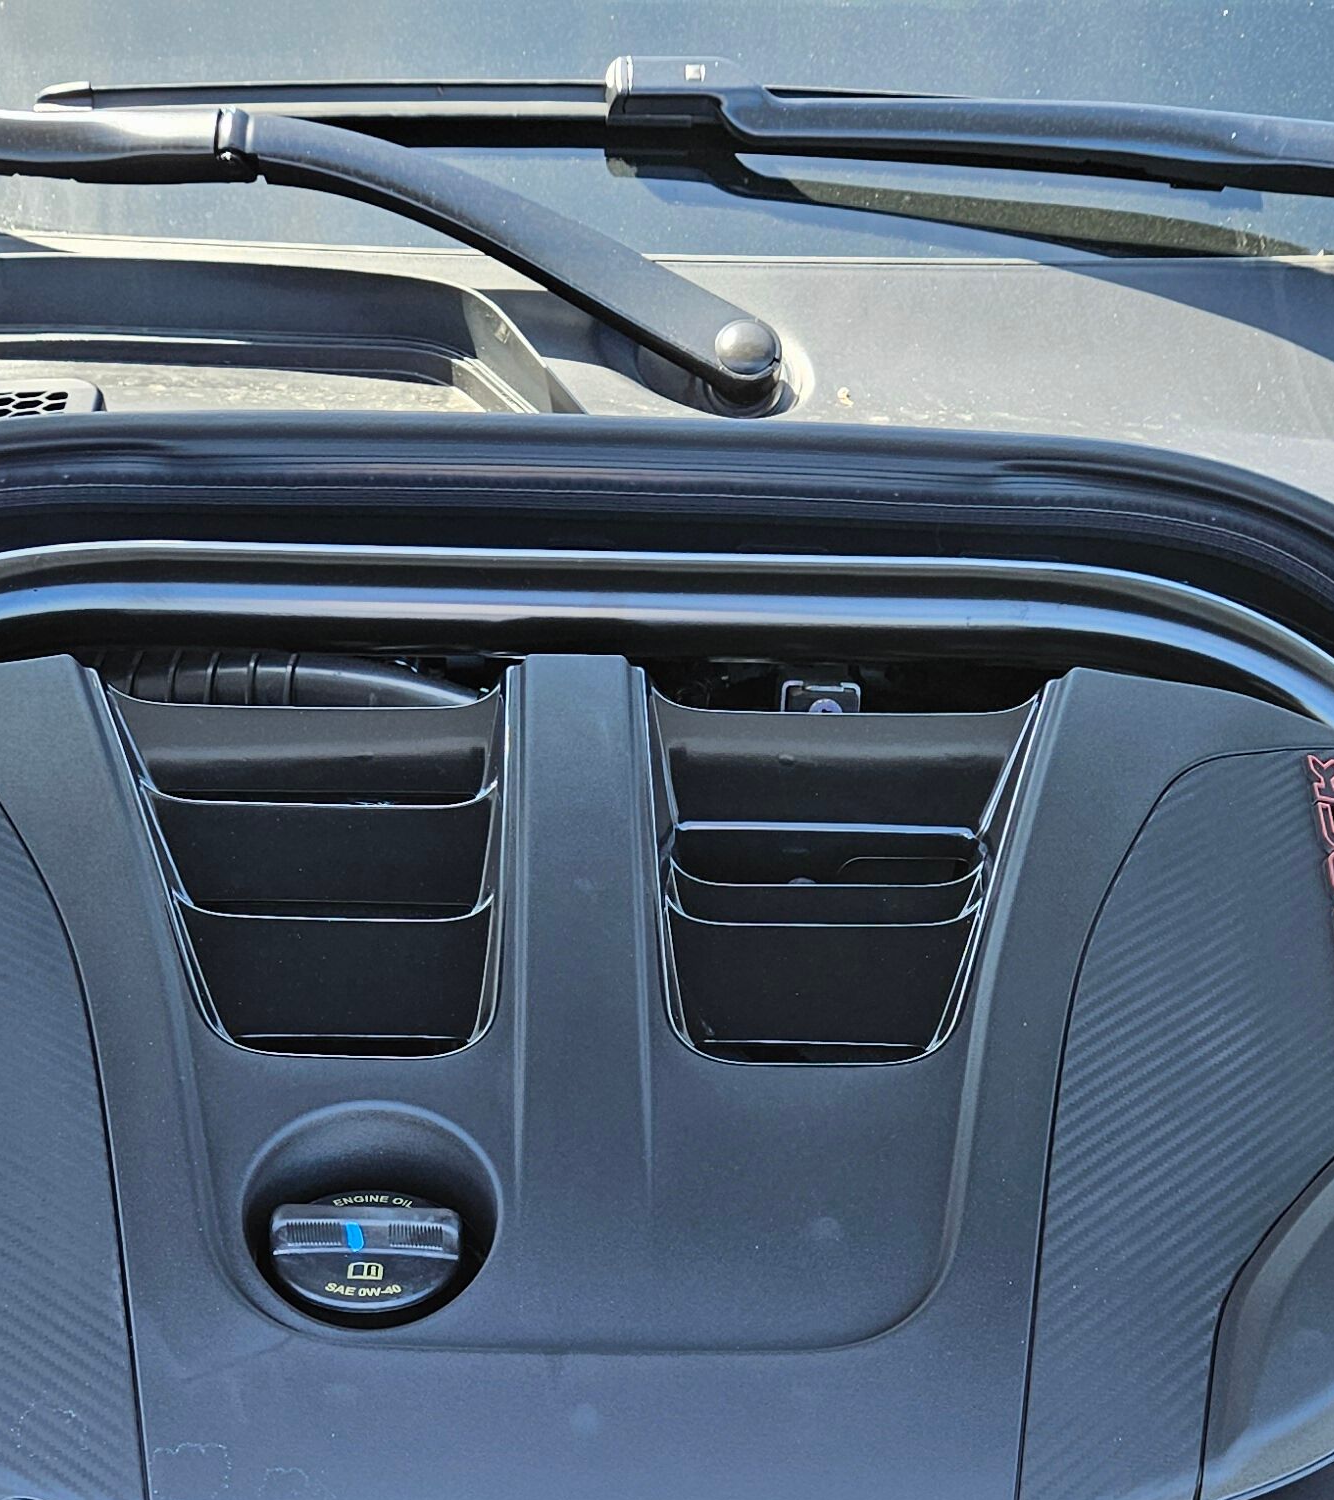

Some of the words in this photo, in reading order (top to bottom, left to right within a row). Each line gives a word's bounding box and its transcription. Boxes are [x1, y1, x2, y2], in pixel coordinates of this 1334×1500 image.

[332, 1194, 390, 1208] ENGINE
[392, 1197, 414, 1209] OIL
[325, 1282, 357, 1296] SAE
[358, 1284, 403, 1297] 0W-40
